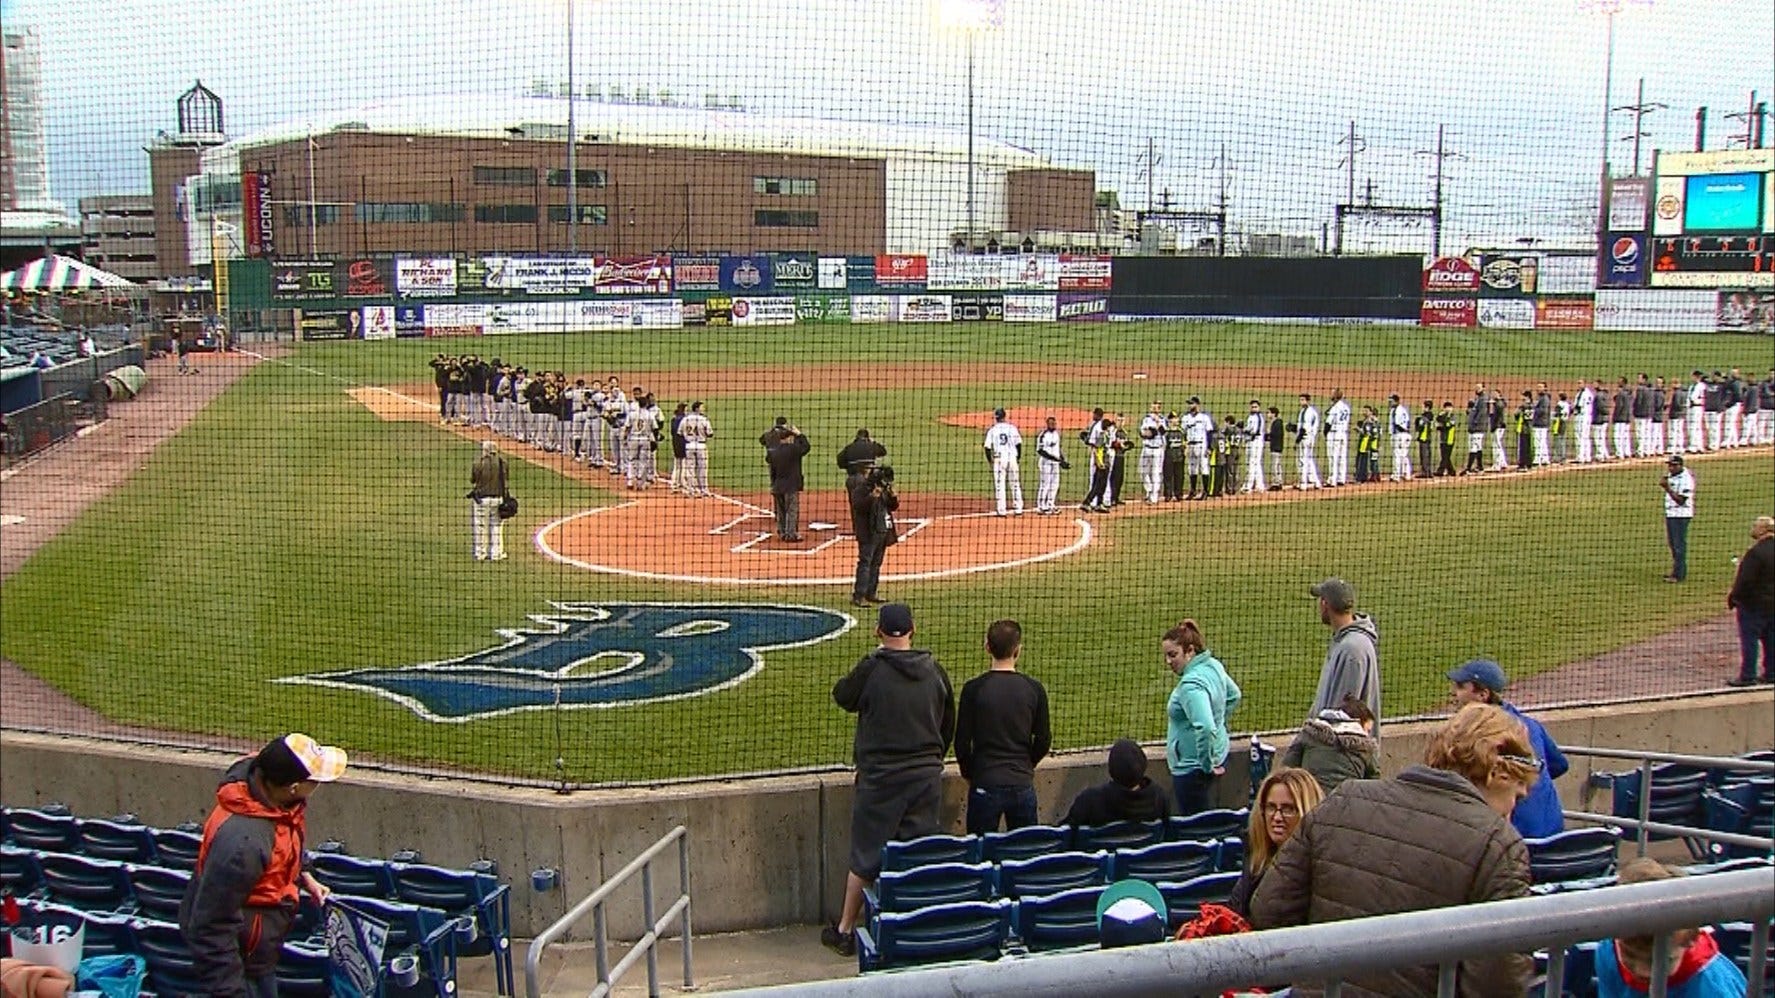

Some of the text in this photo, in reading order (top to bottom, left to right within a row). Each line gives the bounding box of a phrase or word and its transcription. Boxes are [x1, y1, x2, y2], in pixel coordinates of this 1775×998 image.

[260, 187, 273, 241] UCONN
[515, 268, 548, 277] FRANK
[685, 424, 699, 436] 24
[999, 433, 1008, 446] 9
